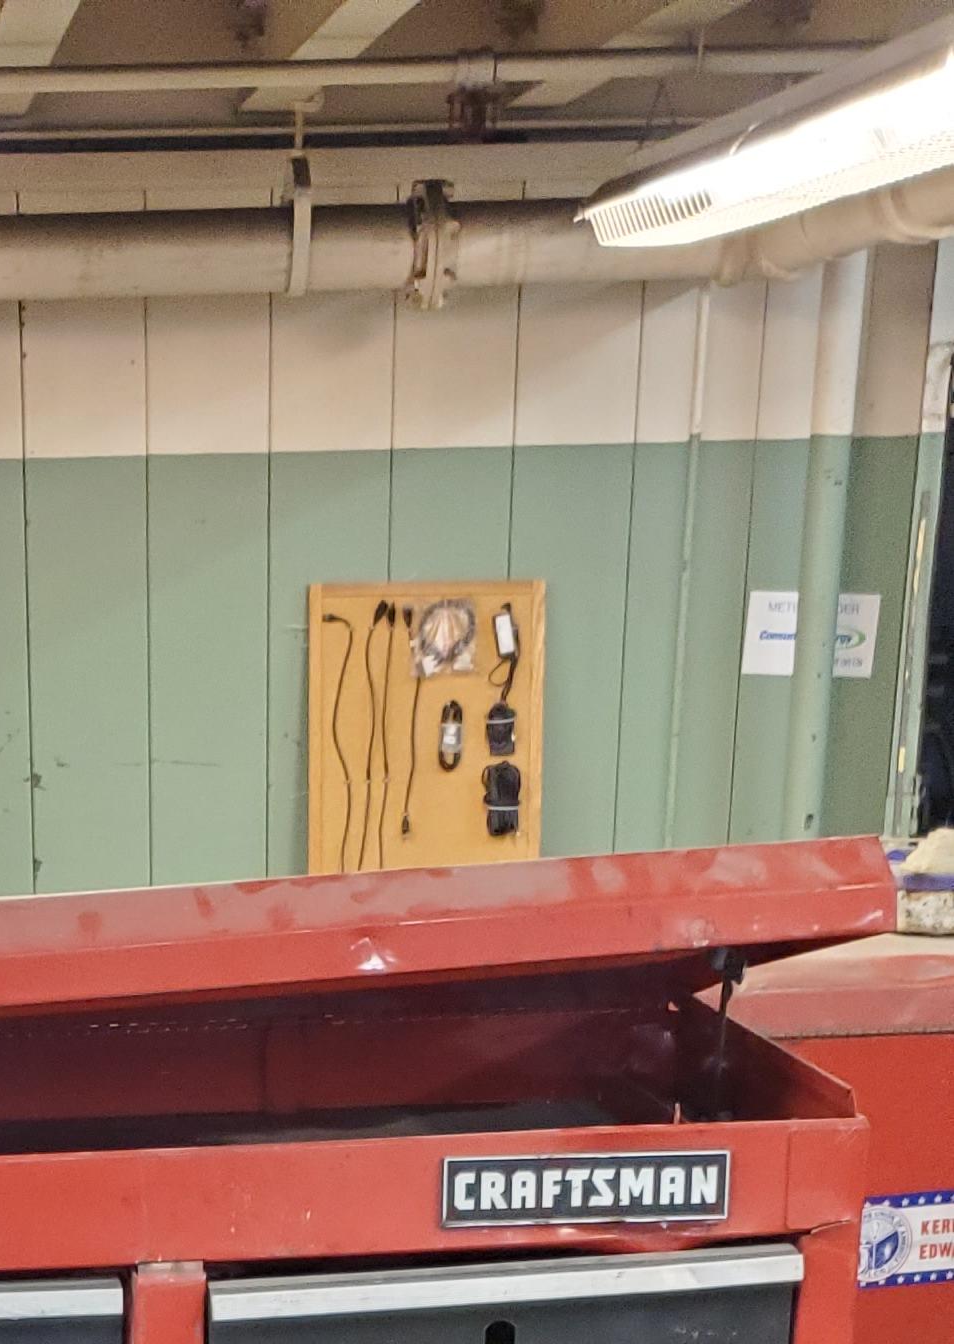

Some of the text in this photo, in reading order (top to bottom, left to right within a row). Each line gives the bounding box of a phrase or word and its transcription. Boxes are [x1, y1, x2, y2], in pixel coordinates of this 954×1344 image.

[454, 1164, 718, 1211] CRAFTSMAN
[920, 1218, 954, 1236] KER
[918, 1242, 954, 1260] EDW
